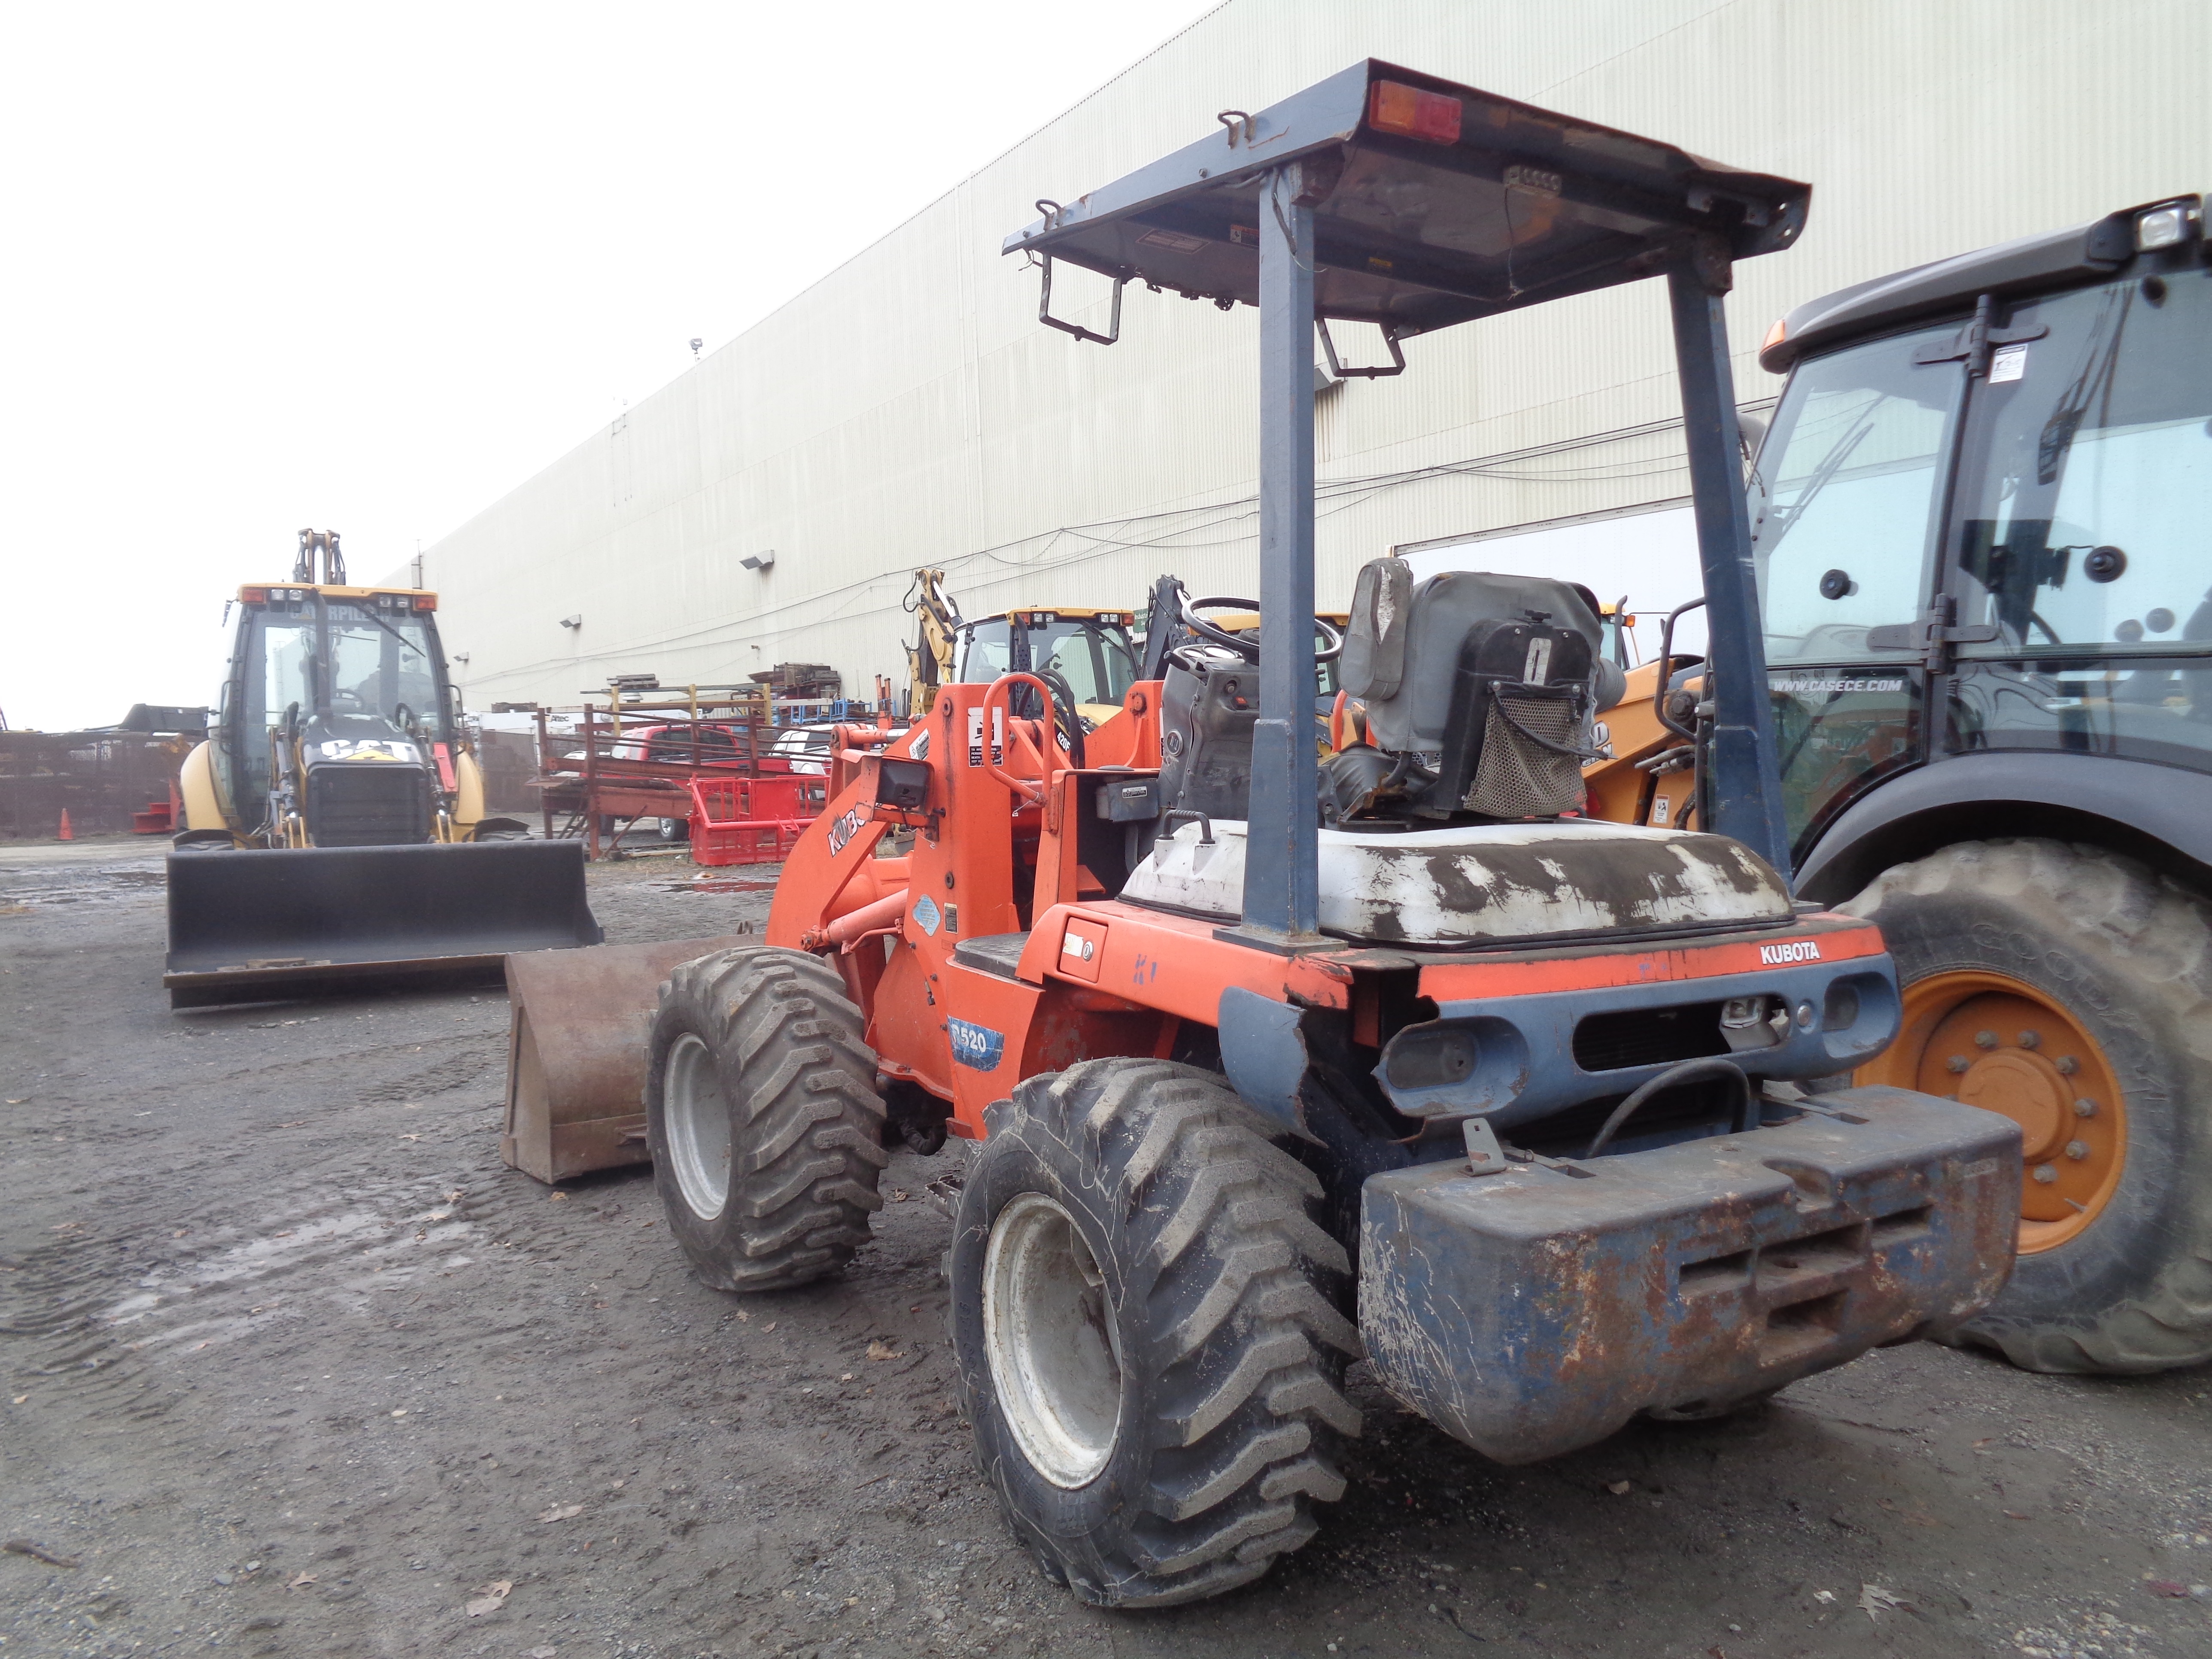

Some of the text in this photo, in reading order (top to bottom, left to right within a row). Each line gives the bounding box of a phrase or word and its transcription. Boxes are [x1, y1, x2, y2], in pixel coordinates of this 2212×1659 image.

[1774, 680, 1903, 692] WWW.CASECE.COM
[320, 739, 412, 762] CAT
[1057, 731, 1070, 752] 420F
[1760, 941, 1821, 965] KUBOTA
